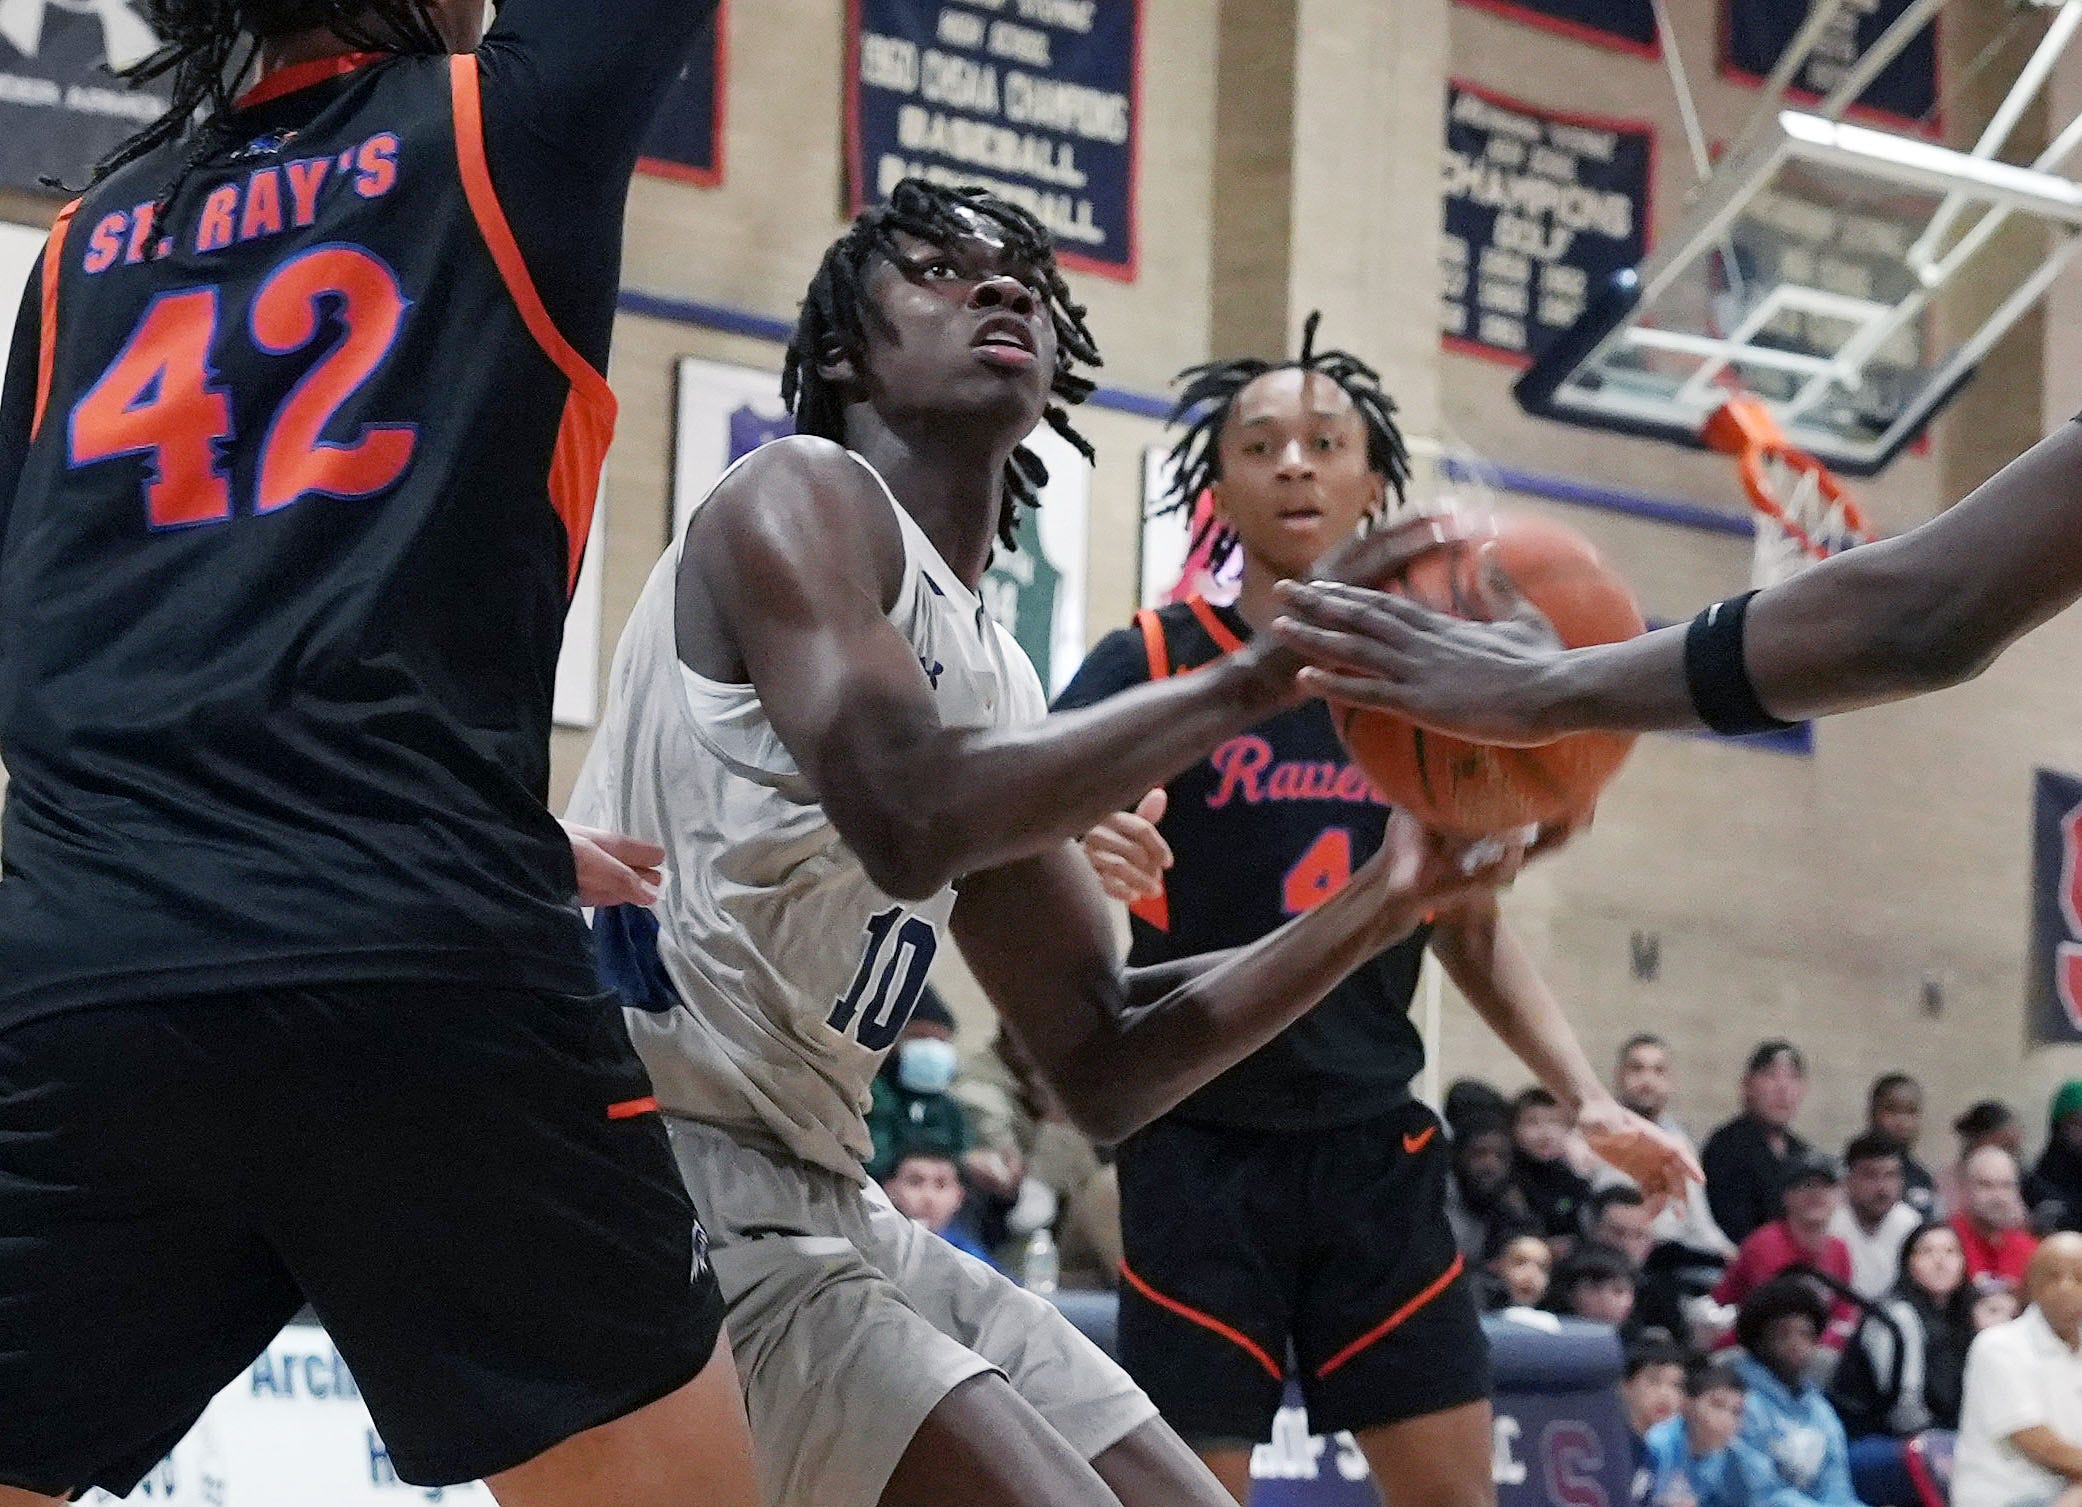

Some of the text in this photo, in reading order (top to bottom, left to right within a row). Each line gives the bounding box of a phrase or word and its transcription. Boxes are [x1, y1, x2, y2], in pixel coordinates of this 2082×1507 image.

[83, 131, 400, 275] ST. RAY'S
[898, 104, 1088, 189] BASEBALL
[67, 241, 419, 531] 42
[1281, 826, 1352, 918] 4
[822, 903, 937, 1054] 10
